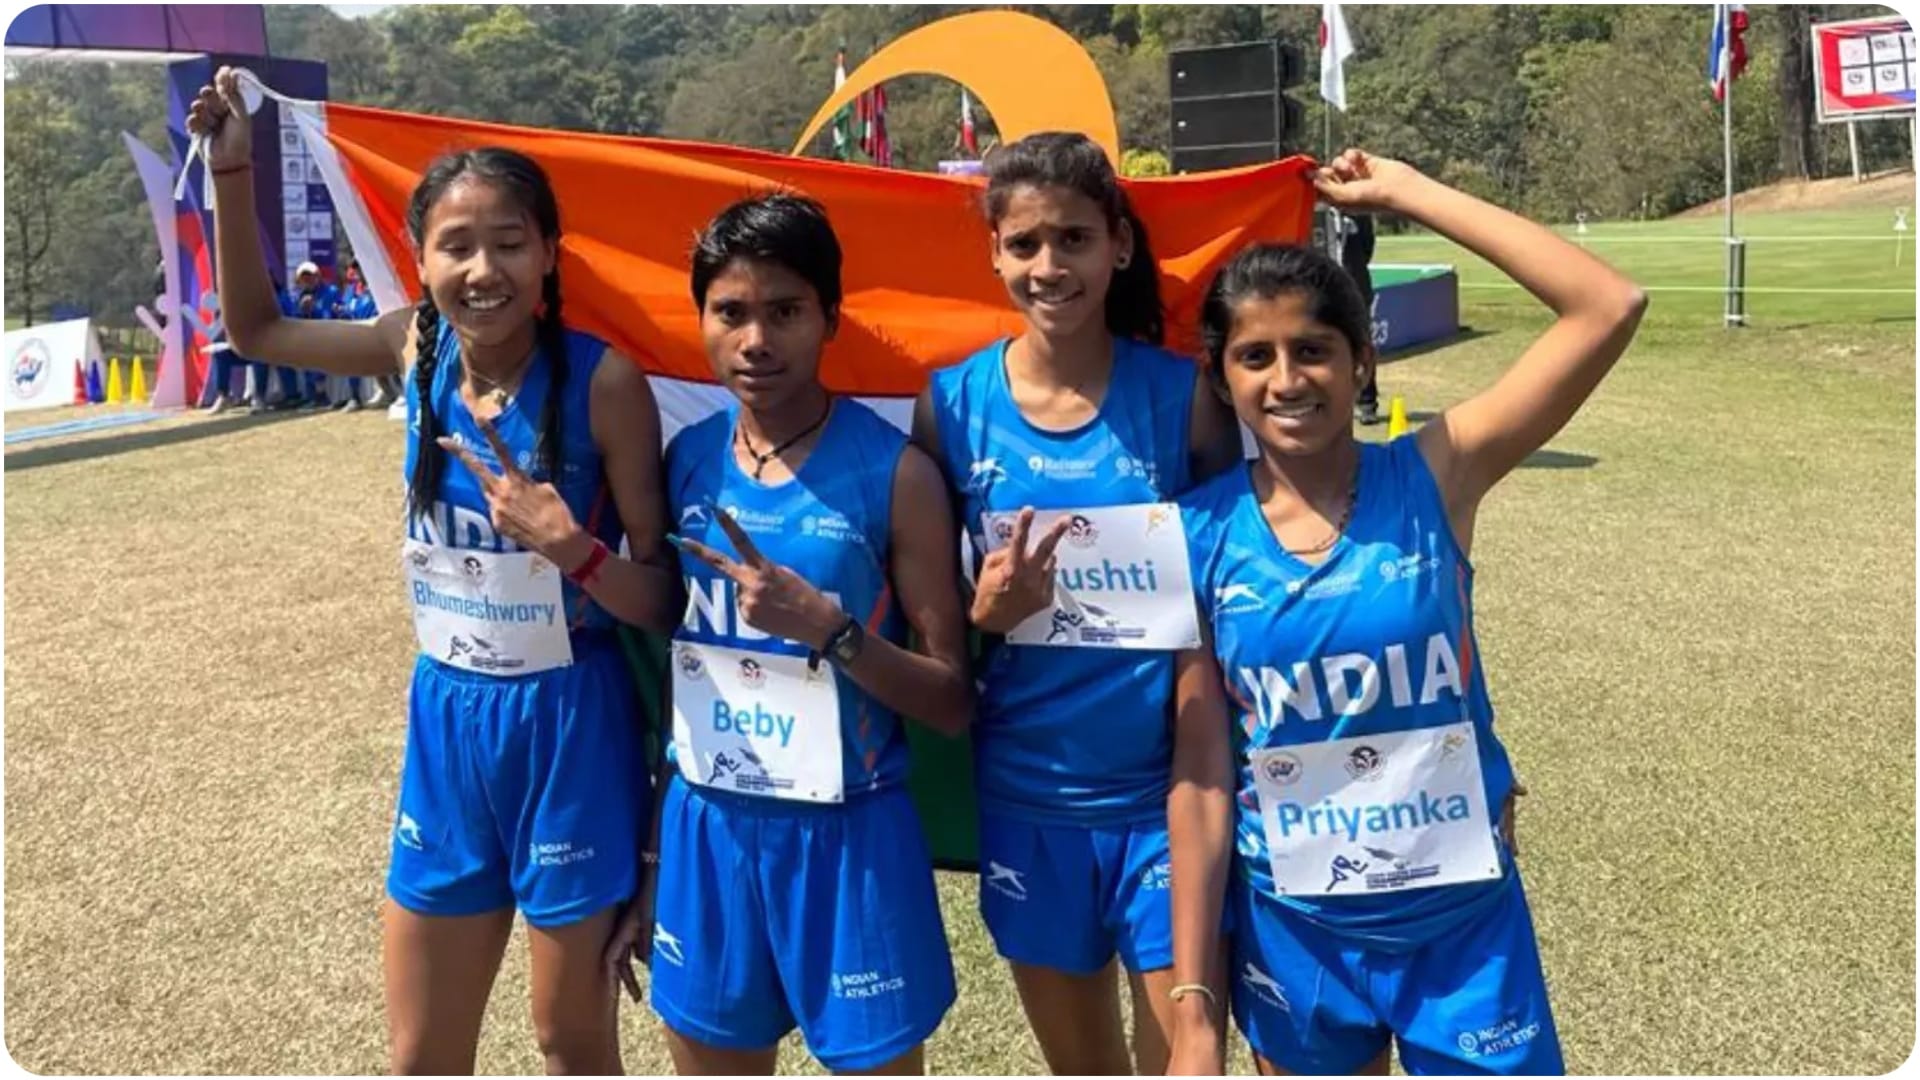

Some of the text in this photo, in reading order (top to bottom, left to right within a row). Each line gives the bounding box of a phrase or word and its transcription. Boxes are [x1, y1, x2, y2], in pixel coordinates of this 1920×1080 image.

[1052, 557, 1158, 593] ushti
[413, 579, 557, 626] Bhumeshwory
[1238, 631, 1464, 730] INDIA
[712, 699, 796, 748] Beby
[1276, 790, 1471, 843] Priyanka
[538, 842, 572, 855] INDIAN
[539, 848, 595, 866] ATHLETICS
[841, 970, 880, 987] INDIAN
[845, 976, 905, 999] ATHLETICS
